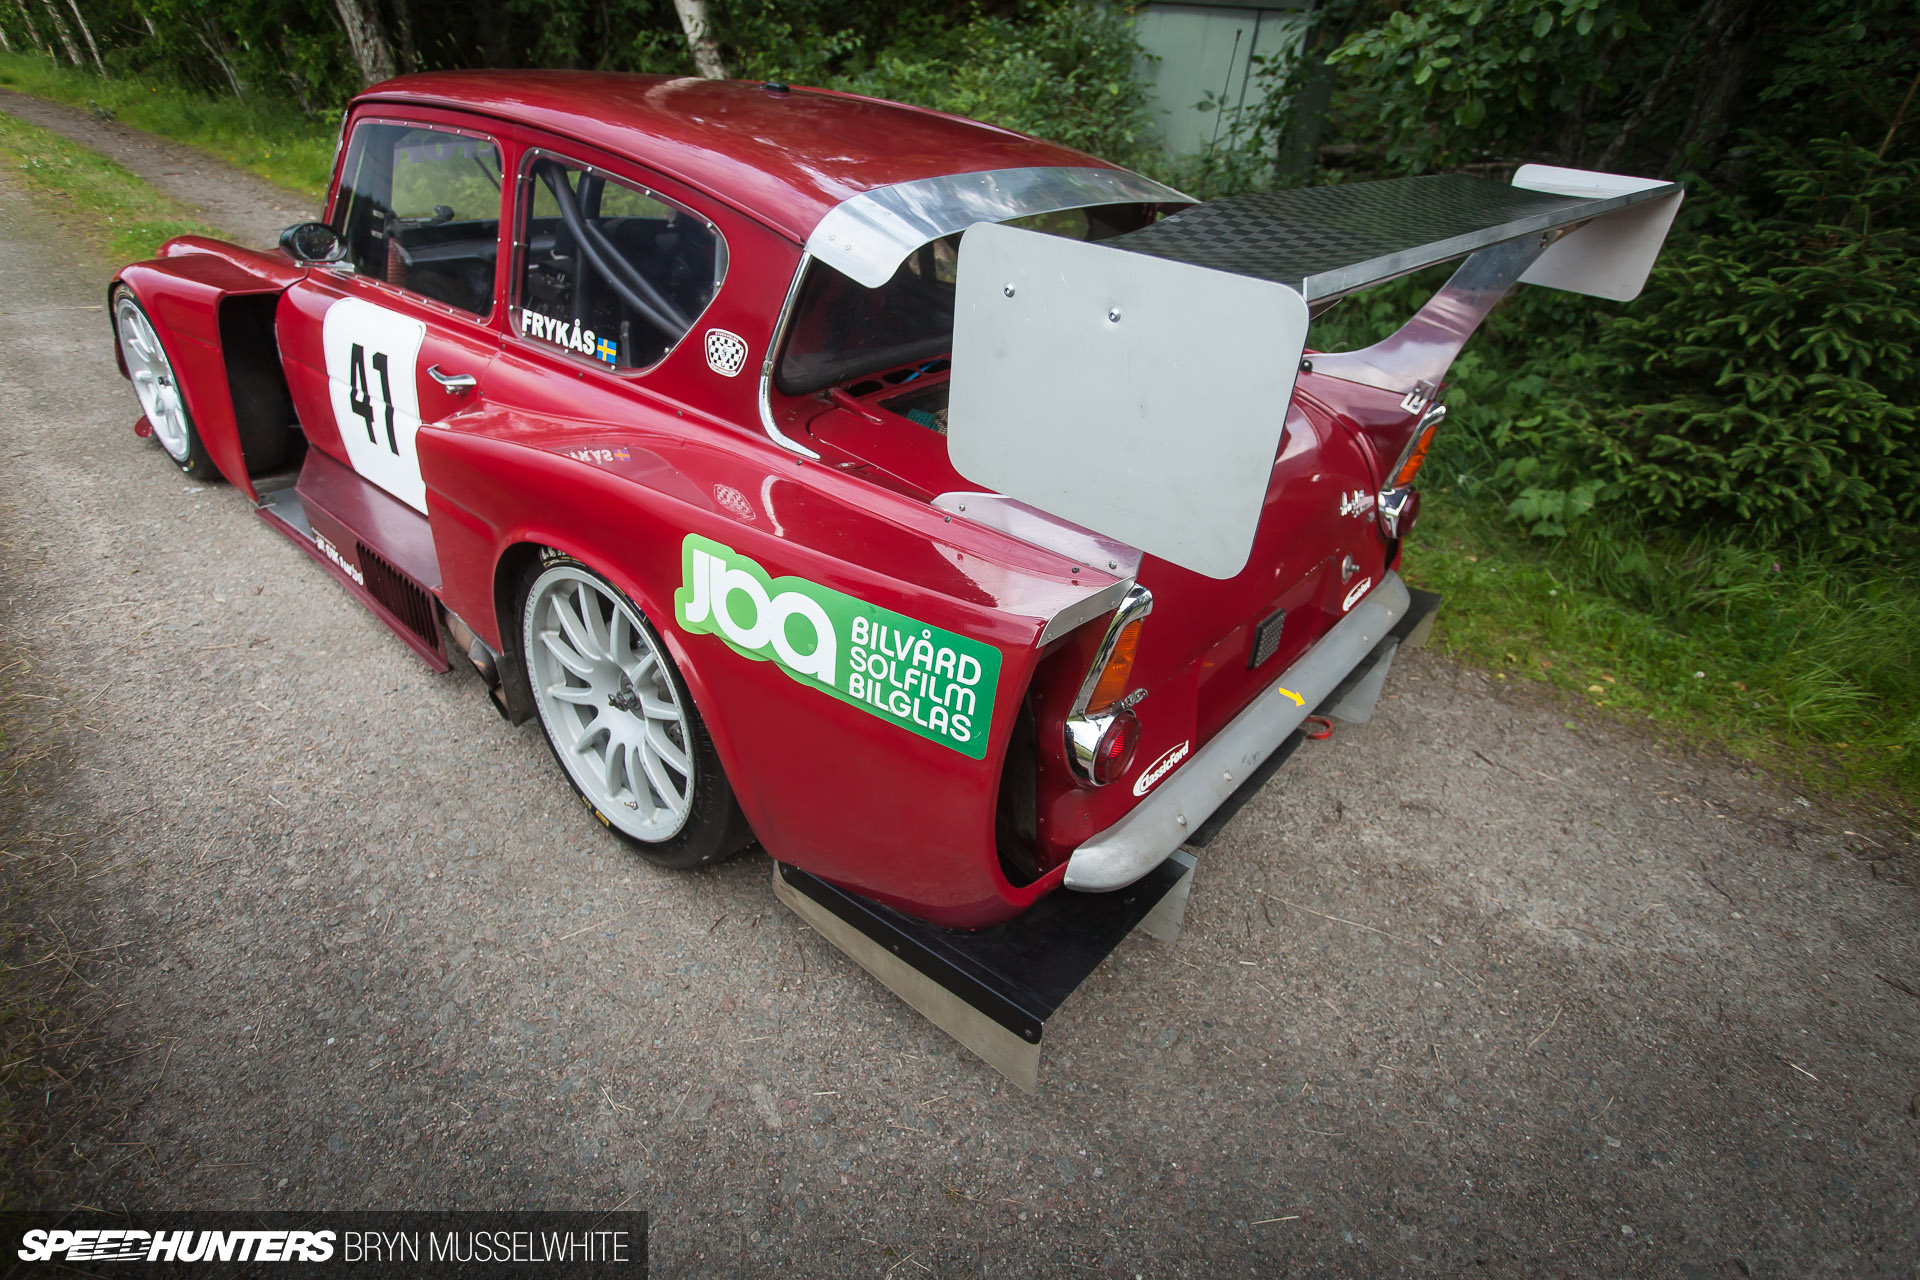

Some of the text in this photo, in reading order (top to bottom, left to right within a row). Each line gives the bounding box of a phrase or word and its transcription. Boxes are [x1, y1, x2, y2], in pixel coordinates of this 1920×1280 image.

[521, 309, 596, 357] FRYKÅS
[350, 342, 400, 456] 41
[849, 646, 976, 716] SOLFILM
[851, 616, 982, 686] BILVÅRD
[849, 672, 972, 743] BILGLAS
